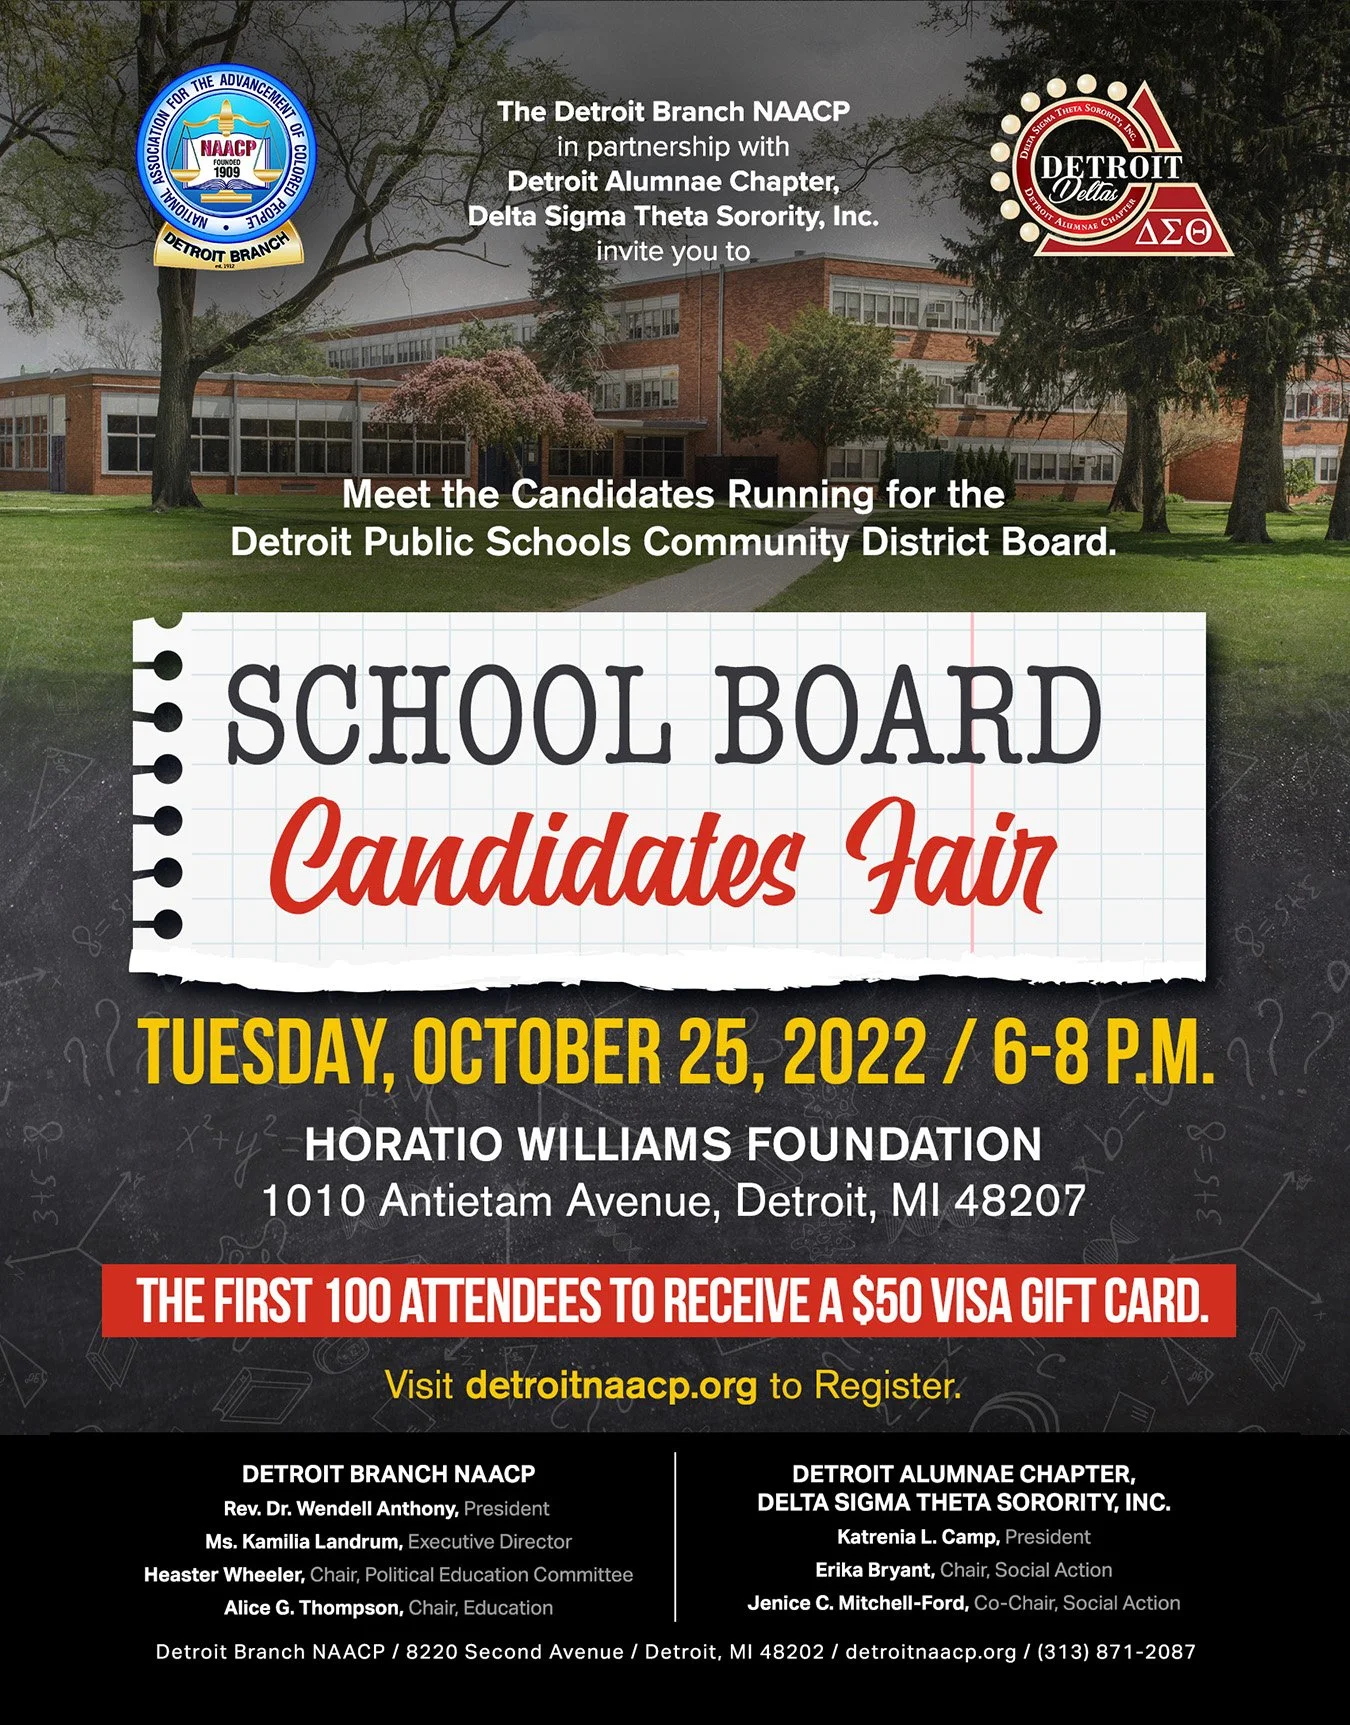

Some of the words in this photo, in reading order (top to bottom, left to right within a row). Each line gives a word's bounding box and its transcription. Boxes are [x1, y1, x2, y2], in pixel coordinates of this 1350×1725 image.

[191, 75, 214, 92] THE
[166, 88, 190, 109] FOR
[220, 74, 296, 119] ADVANCEMENT
[497, 101, 546, 121] The
[556, 100, 644, 121] Detroit
[653, 101, 744, 121] Branch
[754, 101, 850, 122] NAACP
[290, 122, 304, 138] OF
[147, 112, 170, 185] ASSOCIATION
[200, 140, 256, 156] NAACP
[558, 136, 577, 156] in
[588, 136, 730, 161] partnership
[738, 136, 789, 156] with
[214, 167, 240, 178] 1909
[284, 145, 306, 197] COLORED
[1040, 156, 1183, 179] DETROIT
[509, 170, 598, 191] Detroit
[605, 171, 722, 191] Alumnae
[730, 170, 839, 196] Chapter,
[1048, 175, 1118, 204] Deltas
[161, 188, 208, 229] NATIONAL
[245, 200, 286, 229] PEOPLE
[469, 205, 536, 226] Delta
[545, 205, 625, 231] Sigma
[634, 205, 708, 226] Theta
[717, 205, 825, 231] Sorority,
[834, 205, 879, 226] Inc.
[163, 232, 226, 262] DETROIT
[230, 231, 290, 263] BRANCH
[598, 240, 663, 261] invite
[671, 245, 717, 266] you
[726, 242, 750, 261] to
[344, 479, 430, 508] Meet
[442, 479, 498, 508] the
[512, 478, 714, 508] Candidates
[730, 479, 873, 514] Running
[887, 479, 936, 508] for
[948, 479, 1004, 508] the
[233, 527, 351, 556] Detroit
[366, 527, 473, 556] Public
[487, 526, 630, 556] Schools
[644, 526, 849, 562] Community
[863, 527, 989, 556] District
[1003, 527, 1115, 556] Board.
[228, 664, 671, 765] SCHOOL
[715, 665, 1100, 765] BOARD
[270, 797, 805, 914] Candidates
[846, 797, 1057, 914] Fair
[138, 1017, 394, 1093] TUESDAY,
[414, 1017, 660, 1084] OCTOBER
[680, 1018, 763, 1093] 25,
[785, 1017, 926, 1084] 2022
[943, 1018, 977, 1083] /
[994, 1018, 1088, 1084] 6-8
[1108, 1018, 1214, 1084] P.M.
[307, 1126, 502, 1161] HORATIO
[518, 1126, 731, 1161] WILLIAMS
[749, 1126, 1040, 1161] FOUNDATION
[264, 1184, 364, 1216] 1010
[379, 1183, 551, 1217] Antietam
[566, 1183, 719, 1223] Avenue,
[738, 1183, 875, 1223] Detroit,
[893, 1183, 938, 1216] MI
[955, 1184, 1085, 1216] 48207
[137, 1278, 204, 1322] THE
[216, 1277, 312, 1323] FIRST
[327, 1277, 390, 1323] 100
[400, 1277, 601, 1323] ATTENDEES
[610, 1278, 654, 1323] TO
[665, 1277, 809, 1323] RECEIVE
[819, 1278, 843, 1322] A
[853, 1275, 921, 1325] $50
[931, 1277, 1012, 1323] VISA
[1022, 1277, 1096, 1323] GIFT
[1105, 1277, 1208, 1323] CARD.
[385, 1370, 452, 1399] Visit
[467, 1370, 756, 1405] detroitnaacp.org
[770, 1373, 801, 1399] to
[816, 1370, 960, 1407] Register.
[243, 1465, 344, 1483] DETROIT
[351, 1465, 447, 1483] BRANCH
[455, 1465, 535, 1483] NAACP
[793, 1465, 894, 1483] DETROIT
[899, 1465, 1014, 1483] ALUMNAE
[1020, 1465, 1136, 1485] CHAPTER,
[225, 1501, 261, 1516] Rev.
[267, 1501, 291, 1516] Dr.
[296, 1501, 372, 1516] Wendell
[376, 1501, 459, 1520] Anthony,
[465, 1501, 550, 1516] President
[758, 1493, 829, 1511] DELTA
[835, 1492, 911, 1511] SIGMA
[916, 1493, 992, 1511] THETA
[997, 1493, 1119, 1513] SORORITY,
[1126, 1492, 1170, 1511] INC.
[206, 1534, 237, 1549] Ms.
[243, 1534, 310, 1549] Kamilia
[315, 1534, 403, 1551] Landrum,
[409, 1534, 494, 1549] Executive
[500, 1534, 572, 1549] Director
[838, 1529, 916, 1544] Katrenia
[921, 1529, 937, 1544] L.
[942, 1529, 1000, 1548] Camp,
[1006, 1529, 1091, 1544] President
[145, 1567, 219, 1582] Heaster
[223, 1567, 305, 1584] Wheeler,
[311, 1566, 360, 1584] Chair,
[366, 1567, 433, 1582] Political
[440, 1567, 528, 1582] Education
[534, 1566, 633, 1582] Committee
[816, 1562, 863, 1577] Erika
[869, 1562, 935, 1581] Bryant,
[941, 1562, 989, 1579] Chair,
[996, 1562, 1049, 1577] Social
[1055, 1562, 1112, 1577] Action
[224, 1600, 270, 1615] Alice
[276, 1599, 294, 1615] G.
[299, 1600, 404, 1619] Thompson,
[409, 1600, 458, 1616] Chair,
[465, 1600, 553, 1615] Education
[747, 1595, 811, 1610] Jenice
[816, 1595, 833, 1610] C.
[839, 1595, 969, 1612] Mitchell-Ford,
[975, 1595, 1058, 1612] Co-Chair,
[1064, 1595, 1117, 1610] Social
[1123, 1595, 1180, 1610] Action
[157, 1644, 227, 1659] Detroit
[235, 1644, 304, 1659] Branch
[313, 1643, 385, 1659] NAACP
[392, 1643, 399, 1659] /
[407, 1644, 457, 1659] 8220
[465, 1643, 541, 1659] Second
[549, 1644, 623, 1659] Avenue
[631, 1643, 638, 1659] /
[646, 1644, 721, 1661] Detroit,
[731, 1644, 751, 1659] MI
[760, 1644, 823, 1659] 48202
[831, 1643, 838, 1659] /
[846, 1644, 1016, 1663] detroitnaacp.org
[1024, 1643, 1030, 1659] /
[1038, 1643, 1089, 1662] (313)
[1097, 1644, 1195, 1659] 871-2087
